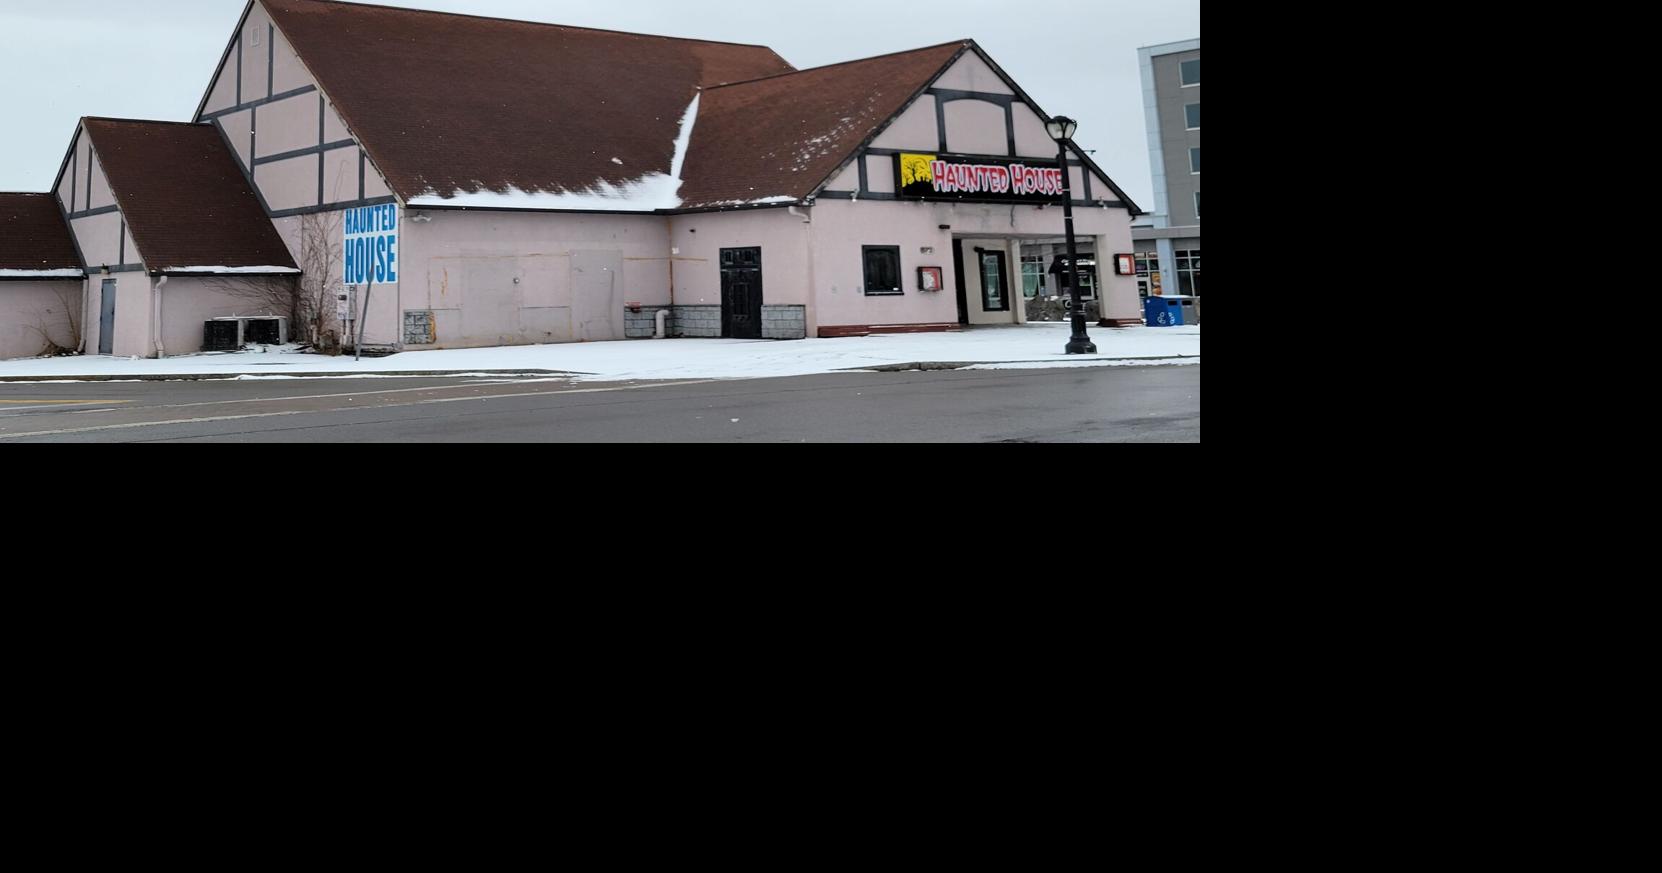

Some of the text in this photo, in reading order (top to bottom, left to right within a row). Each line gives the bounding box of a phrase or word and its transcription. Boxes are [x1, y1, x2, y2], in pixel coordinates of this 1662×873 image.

[930, 160, 1063, 195] HAUNTED HOUSE
[345, 204, 396, 235] HAUNTED
[345, 235, 396, 284] HOUSE
